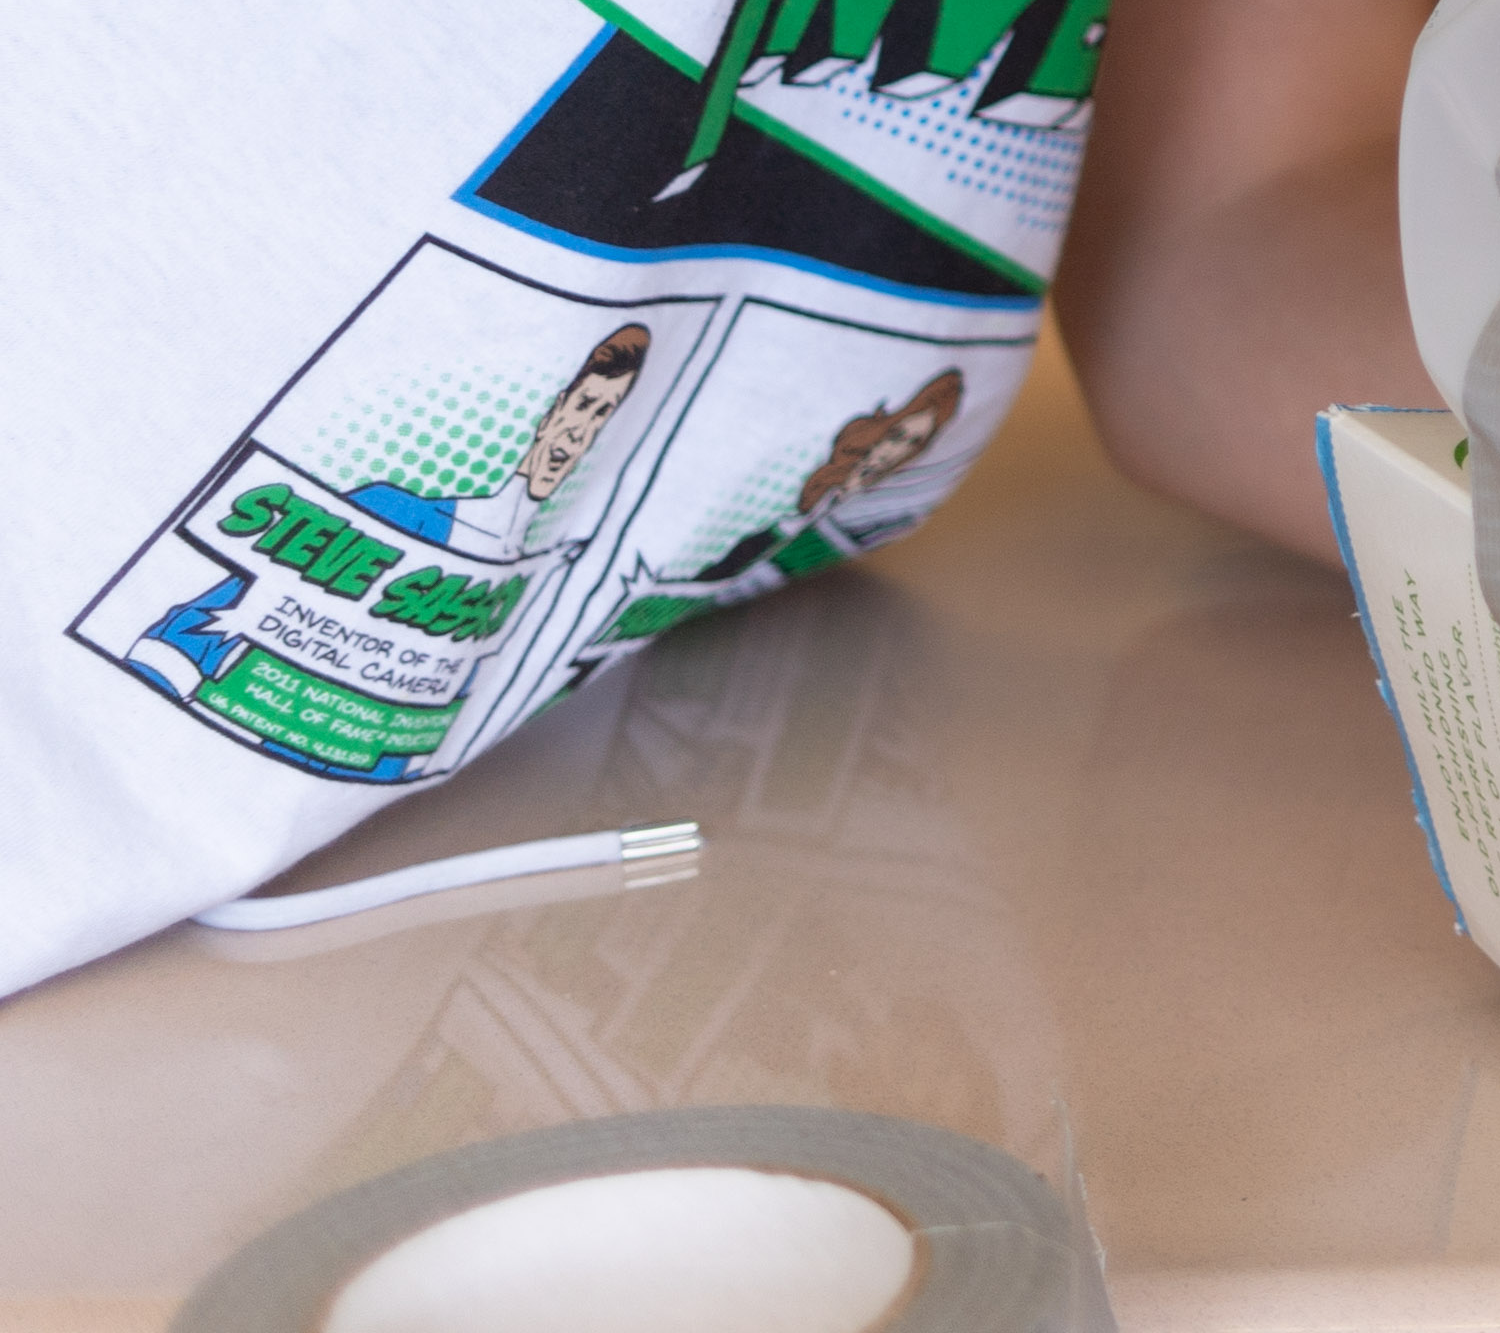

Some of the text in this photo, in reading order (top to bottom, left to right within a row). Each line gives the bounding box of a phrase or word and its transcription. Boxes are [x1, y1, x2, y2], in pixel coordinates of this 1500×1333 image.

[217, 483, 405, 601] STEVE
[257, 614, 450, 695] DIGITAL CAMERA
[274, 595, 394, 656] INVENTOR
[399, 649, 431, 671] OF
[230, 704, 286, 735] PATENT
[245, 683, 294, 715] HALL
[301, 708, 329, 726] OF
[251, 661, 298, 694] 2011
[302, 686, 386, 725] NATIONAL
[1392, 595, 1470, 842] ENJOY MILK THE
[1452, 618, 1491, 749] FLAVOR.
[1403, 567, 1500, 898] OLD-FASHIONED WAY
[1438, 648, 1499, 841] REFRESHING
[1483, 761, 1500, 801] OF
